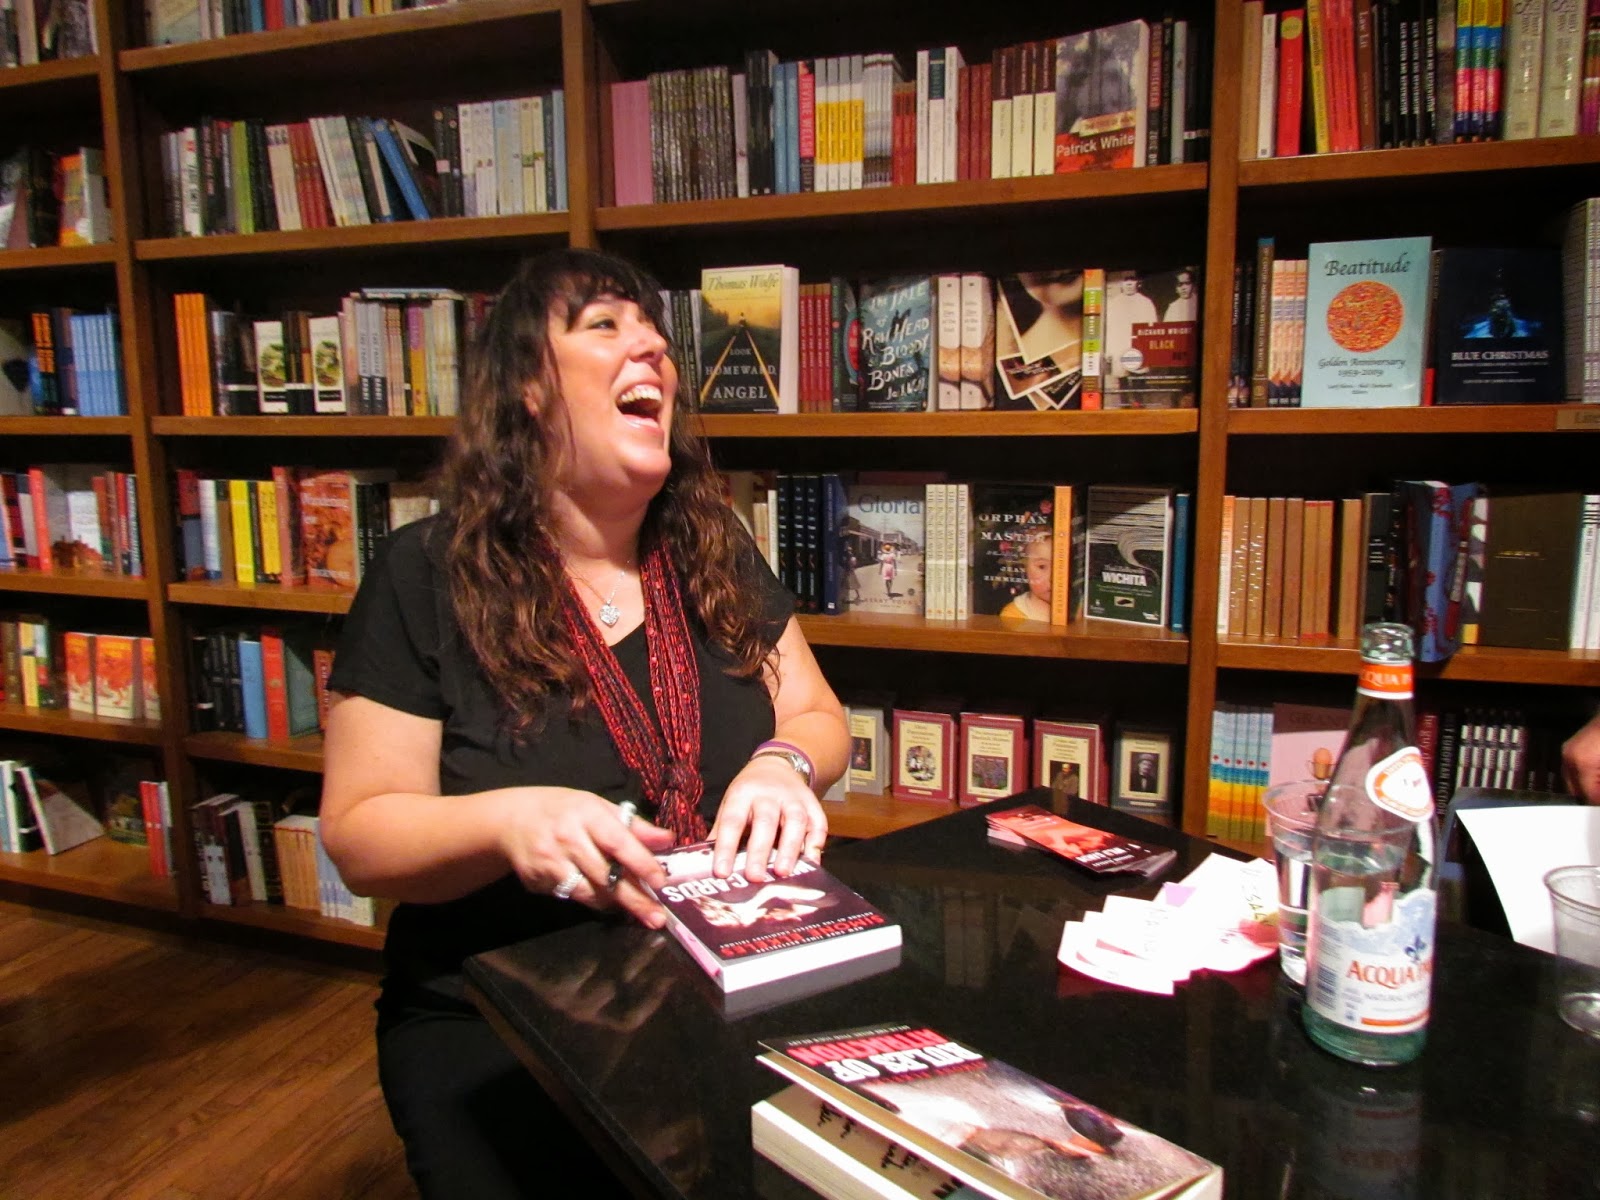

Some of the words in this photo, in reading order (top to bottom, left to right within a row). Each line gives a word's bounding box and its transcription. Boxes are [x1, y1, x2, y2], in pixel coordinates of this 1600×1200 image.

[801, 76, 812, 111] IRVINE
[803, 113, 814, 157] WELSH
[1056, 140, 1097, 158] Patrick
[1101, 133, 1134, 149] White
[1324, 252, 1412, 276] Beatitude
[708, 276, 746, 290] Thomas
[749, 272, 779, 292] Wolfe
[1138, 328, 1165, 336] RICHARD
[730, 348, 751, 356] LOOK
[1149, 340, 1175, 350] BLACK
[1318, 356, 1348, 370] Golden
[1350, 358, 1406, 371] Anniversary
[1451, 351, 1481, 361] BLUE
[1482, 350, 1549, 360] CHRISTMAS
[866, 363, 916, 391] BONES
[1338, 369, 1384, 377] 1959-2009
[713, 386, 768, 399] ANGEL
[859, 494, 921, 514] Gloria
[979, 514, 1048, 525] ORPHAN
[980, 531, 1047, 543] MASTER
[1102, 571, 1147, 587] WICHITA
[1440, 735, 1454, 779] EUROPEAN
[1437, 781, 1451, 815] FICTION
[661, 872, 749, 903] CARDS
[792, 923, 821, 932] PERFECT
[806, 914, 885, 941] SIMONE
[823, 918, 834, 926] THE
[752, 929, 790, 941] CHEMISTRY
[803, 933, 826, 942] TIMES
[828, 929, 845, 937] YORK
[719, 938, 749, 949] TRILOGY
[720, 933, 804, 957] ELKELES
[1346, 959, 1415, 989] ACQUA
[786, 1027, 949, 1066] ATTRACTION
[869, 1042, 984, 1074] RULES
[825, 1059, 880, 1083] OF
